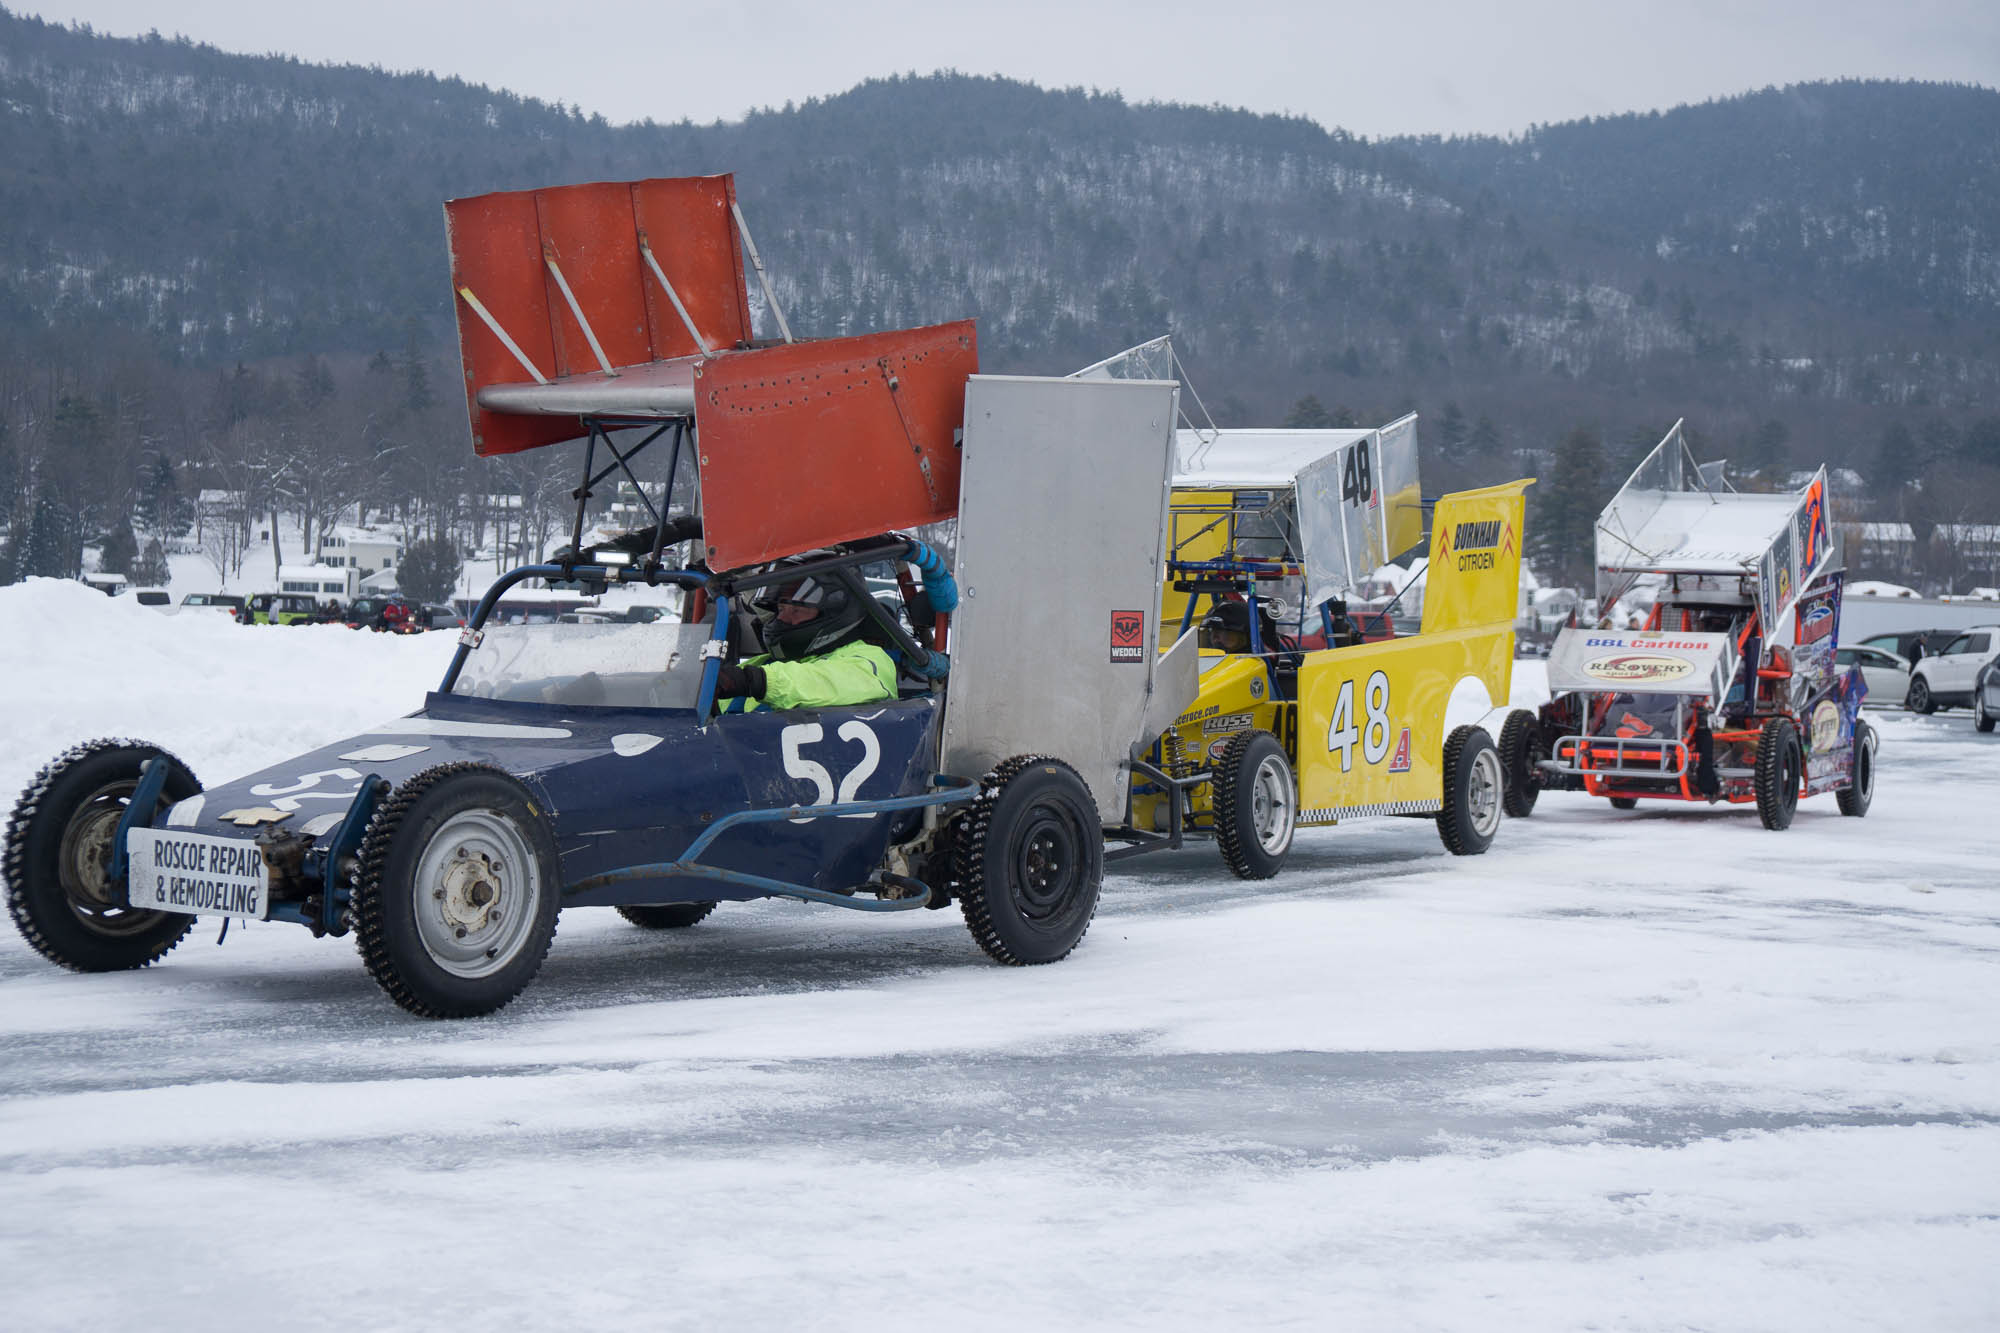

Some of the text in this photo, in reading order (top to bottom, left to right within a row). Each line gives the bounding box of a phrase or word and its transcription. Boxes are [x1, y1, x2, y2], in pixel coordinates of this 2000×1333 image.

[1343, 439, 1372, 508] 48
[1454, 520, 1501, 550] BURNHAM
[1458, 552, 1495, 572] CITROEN
[1111, 647, 1142, 657] WEDDLE
[1585, 638, 1709, 650] BBL Carlton
[1590, 662, 1687, 673] RECOVERY
[1204, 714, 1254, 729] ROSS
[1328, 670, 1390, 773] 48
[1388, 727, 1412, 773] A
[249, 767, 364, 811] 52
[781, 720, 881, 824] 52
[154, 839, 261, 878] ROSCOE REPAIR
[156, 875, 257, 914] & REMODELING
